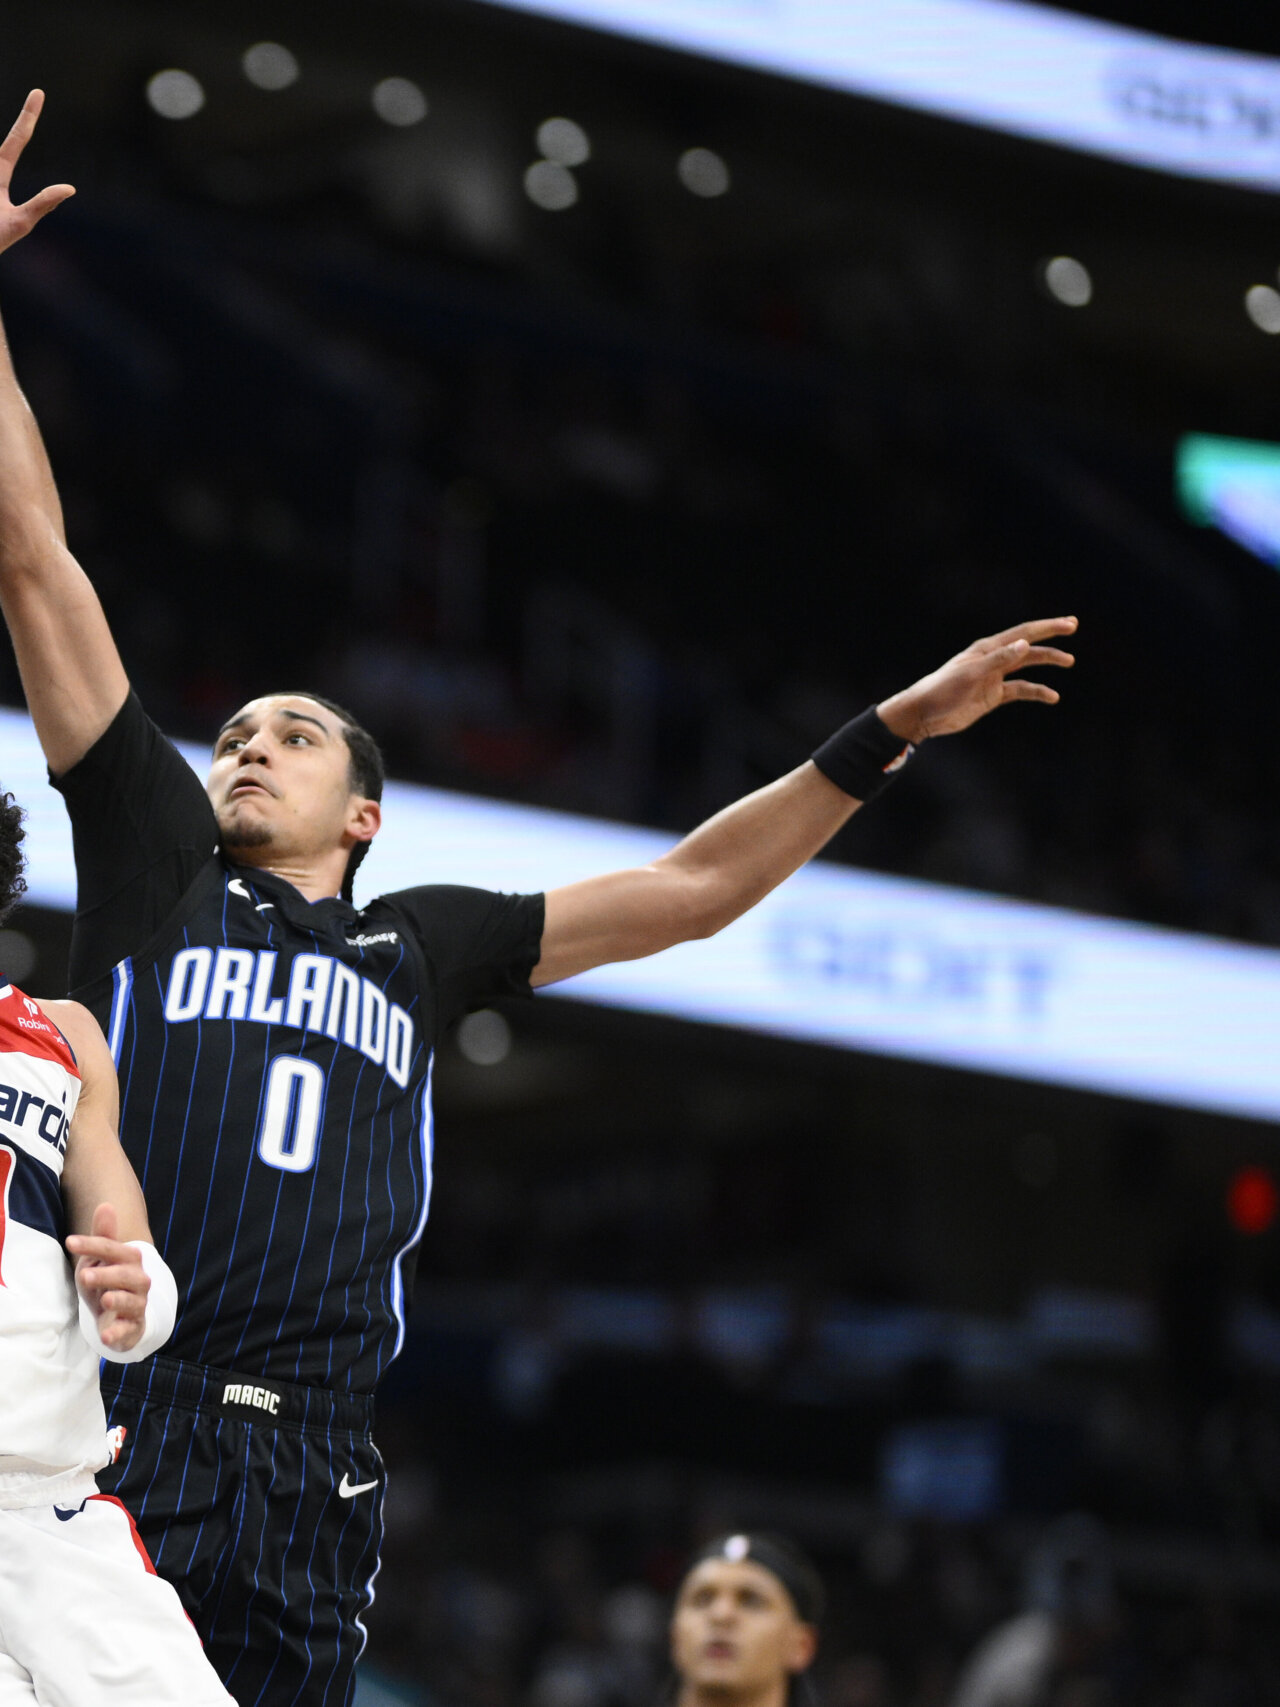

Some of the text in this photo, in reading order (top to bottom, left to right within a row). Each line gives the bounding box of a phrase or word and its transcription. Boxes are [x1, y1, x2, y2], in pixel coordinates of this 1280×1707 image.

[163, 945, 414, 1090] ORLANDO
[257, 1053, 326, 1173] 0
[222, 1384, 281, 1416] MAGIC
